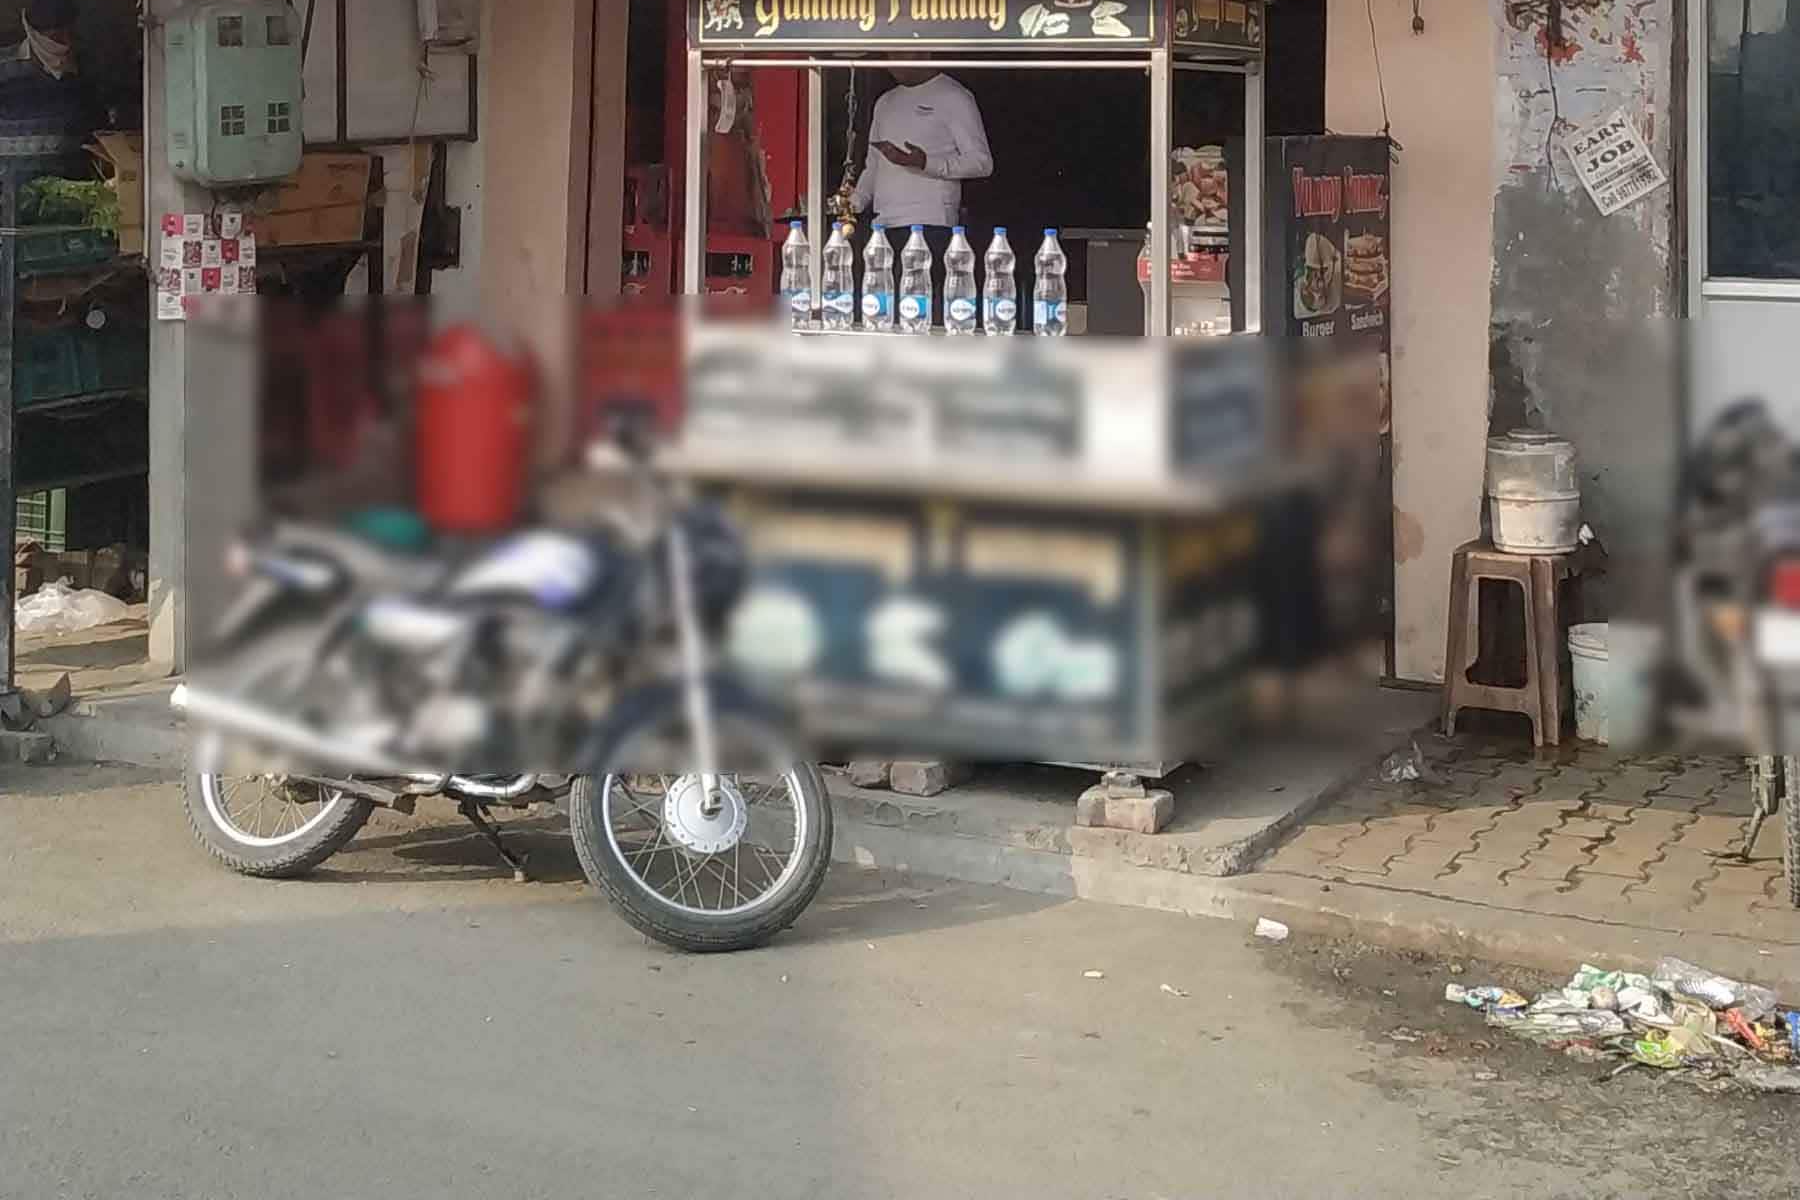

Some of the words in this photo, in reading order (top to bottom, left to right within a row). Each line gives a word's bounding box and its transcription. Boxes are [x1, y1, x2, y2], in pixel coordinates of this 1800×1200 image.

[1573, 119, 1625, 155] EARN
[1587, 140, 1635, 173] JOB
[1302, 320, 1335, 337] Burger
